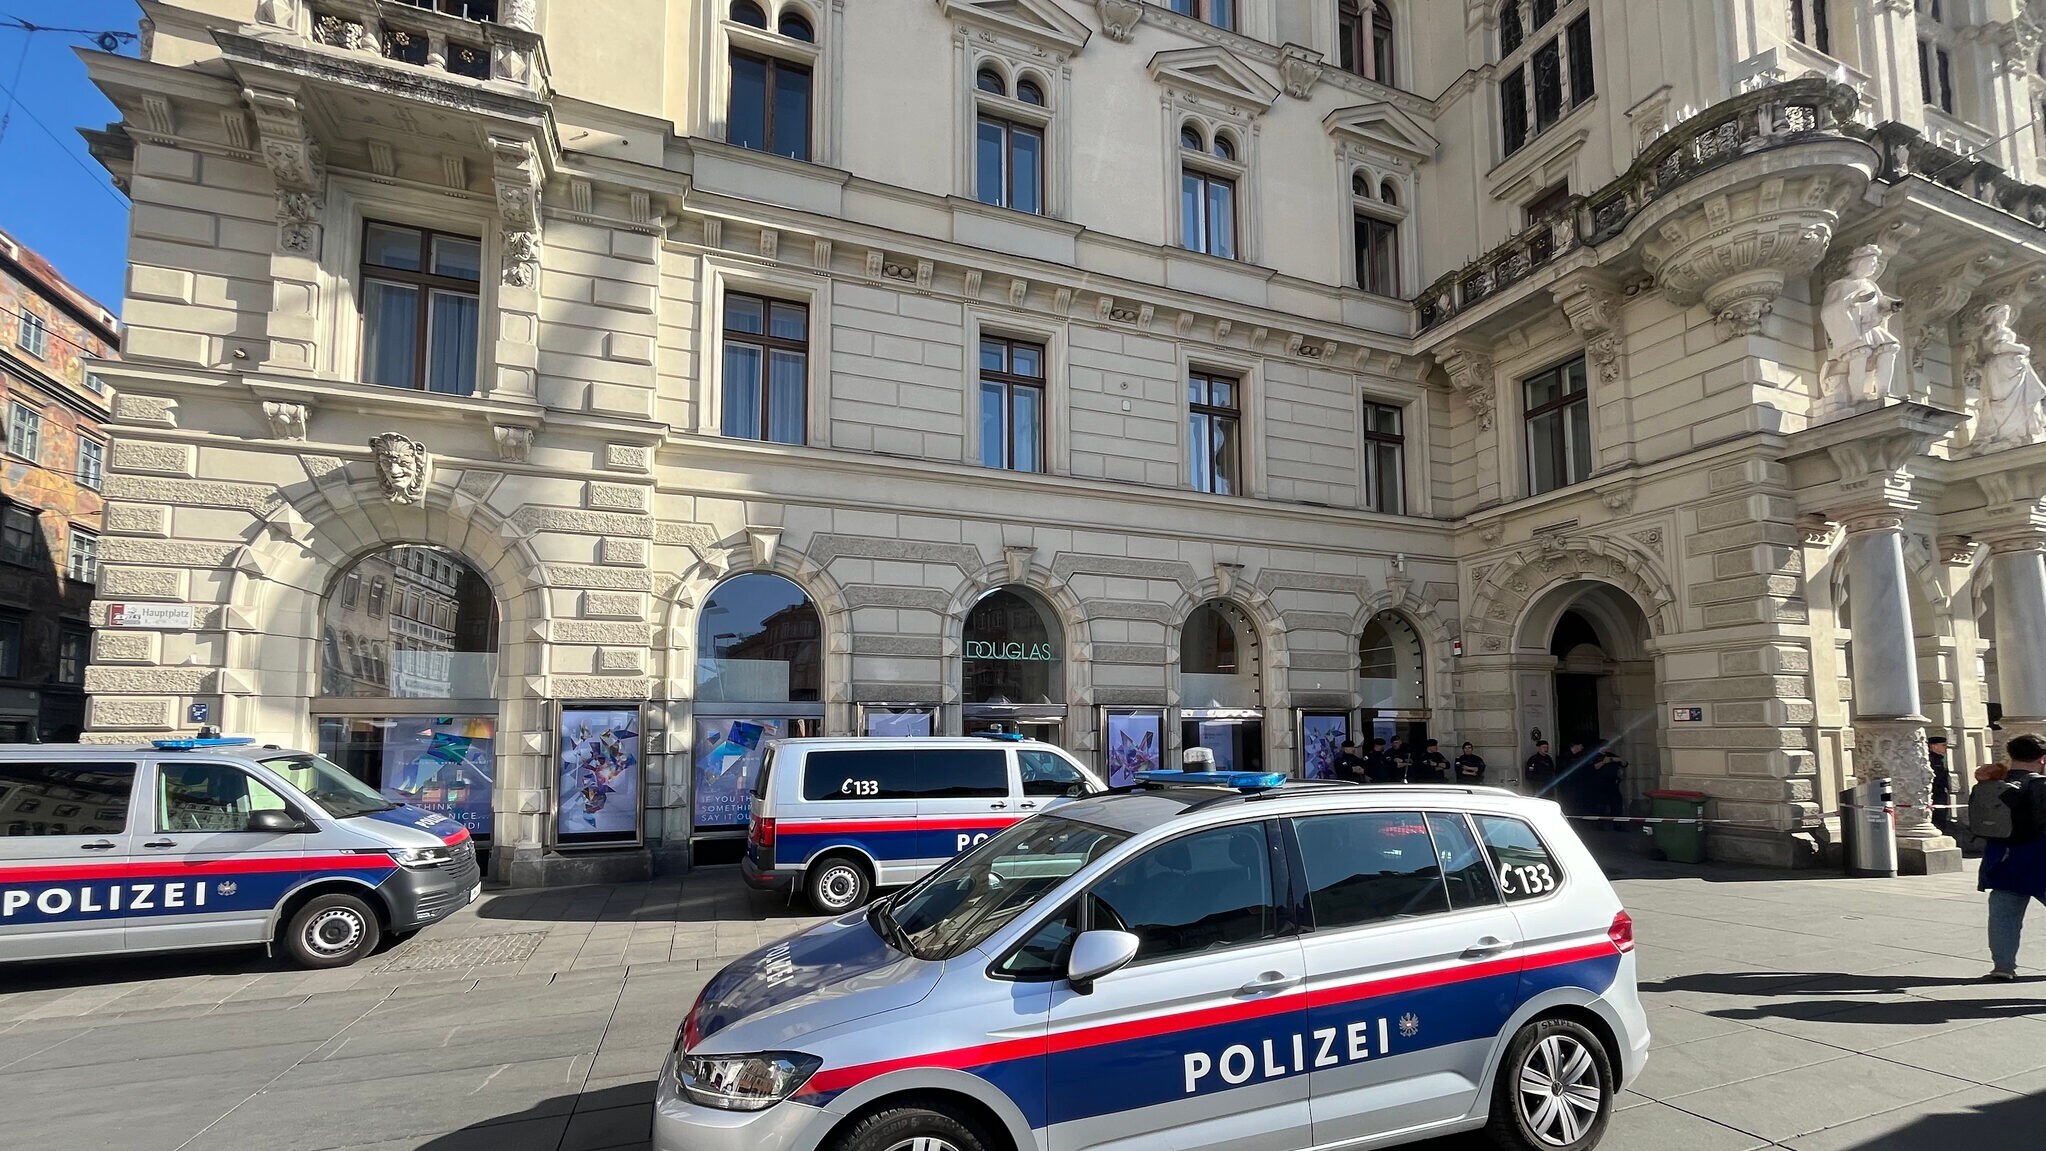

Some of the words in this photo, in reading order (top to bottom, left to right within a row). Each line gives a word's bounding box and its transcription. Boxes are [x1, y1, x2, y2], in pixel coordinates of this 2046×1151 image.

[142, 608, 189, 619] Hauptplatz
[966, 640, 1051, 660] DOUGLAS
[853, 780, 879, 795] 133
[416, 803, 453, 811] THINK
[715, 795, 735, 803] YOU
[1513, 863, 1555, 894] 133
[3, 881, 206, 917] POLIZEI
[766, 941, 794, 988] POLIZEI
[1184, 1017, 1389, 1093] POLIZEI
